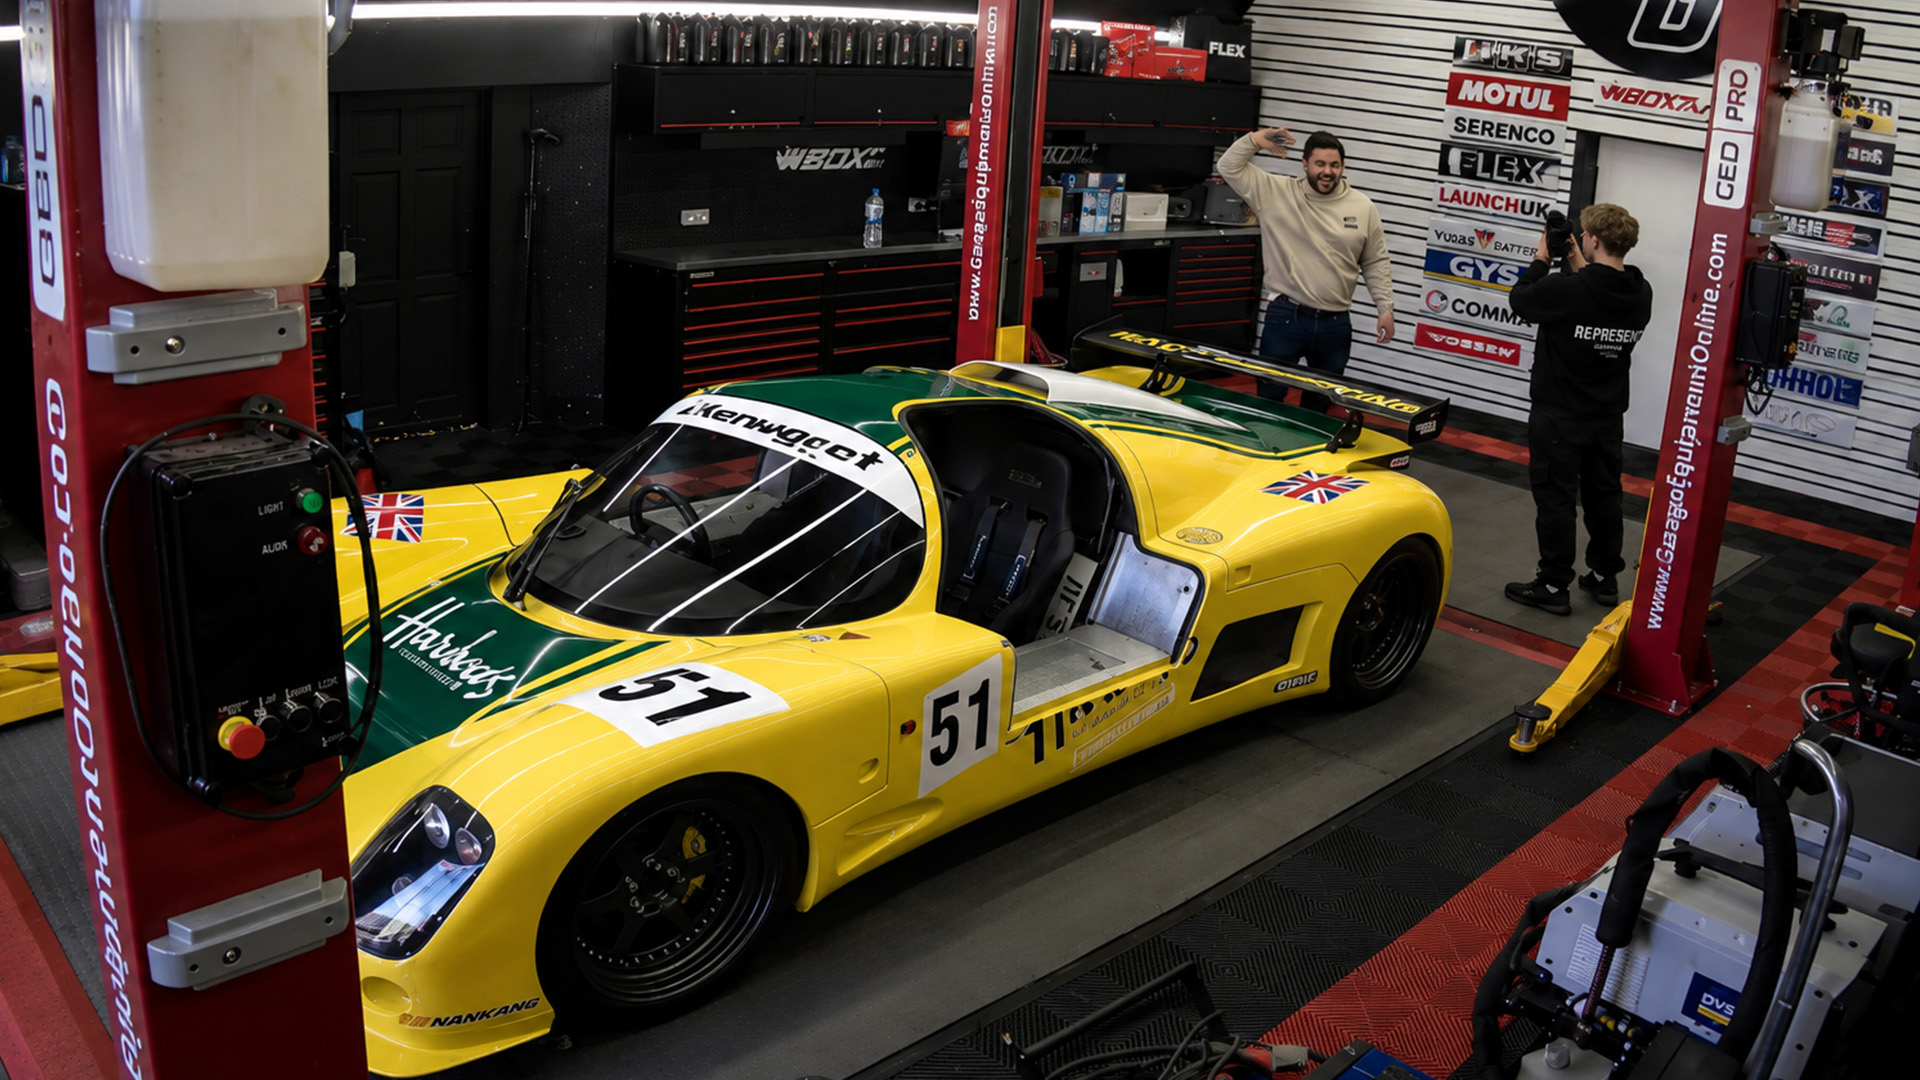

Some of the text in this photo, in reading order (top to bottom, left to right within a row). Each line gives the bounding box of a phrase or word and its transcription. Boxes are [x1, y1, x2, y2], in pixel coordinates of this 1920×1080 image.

[1209, 41, 1246, 58] FLEX
[1458, 79, 1554, 112] MOTUL
[1454, 117, 1555, 145] SERENCO
[1715, 69, 1748, 201] GED PRO
[1494, 241, 1537, 256] BATTER
[1450, 256, 1519, 286] GYS
[599, 668, 751, 726] 51
[930, 678, 990, 767] 51
[430, 998, 540, 1027] NANKANG
